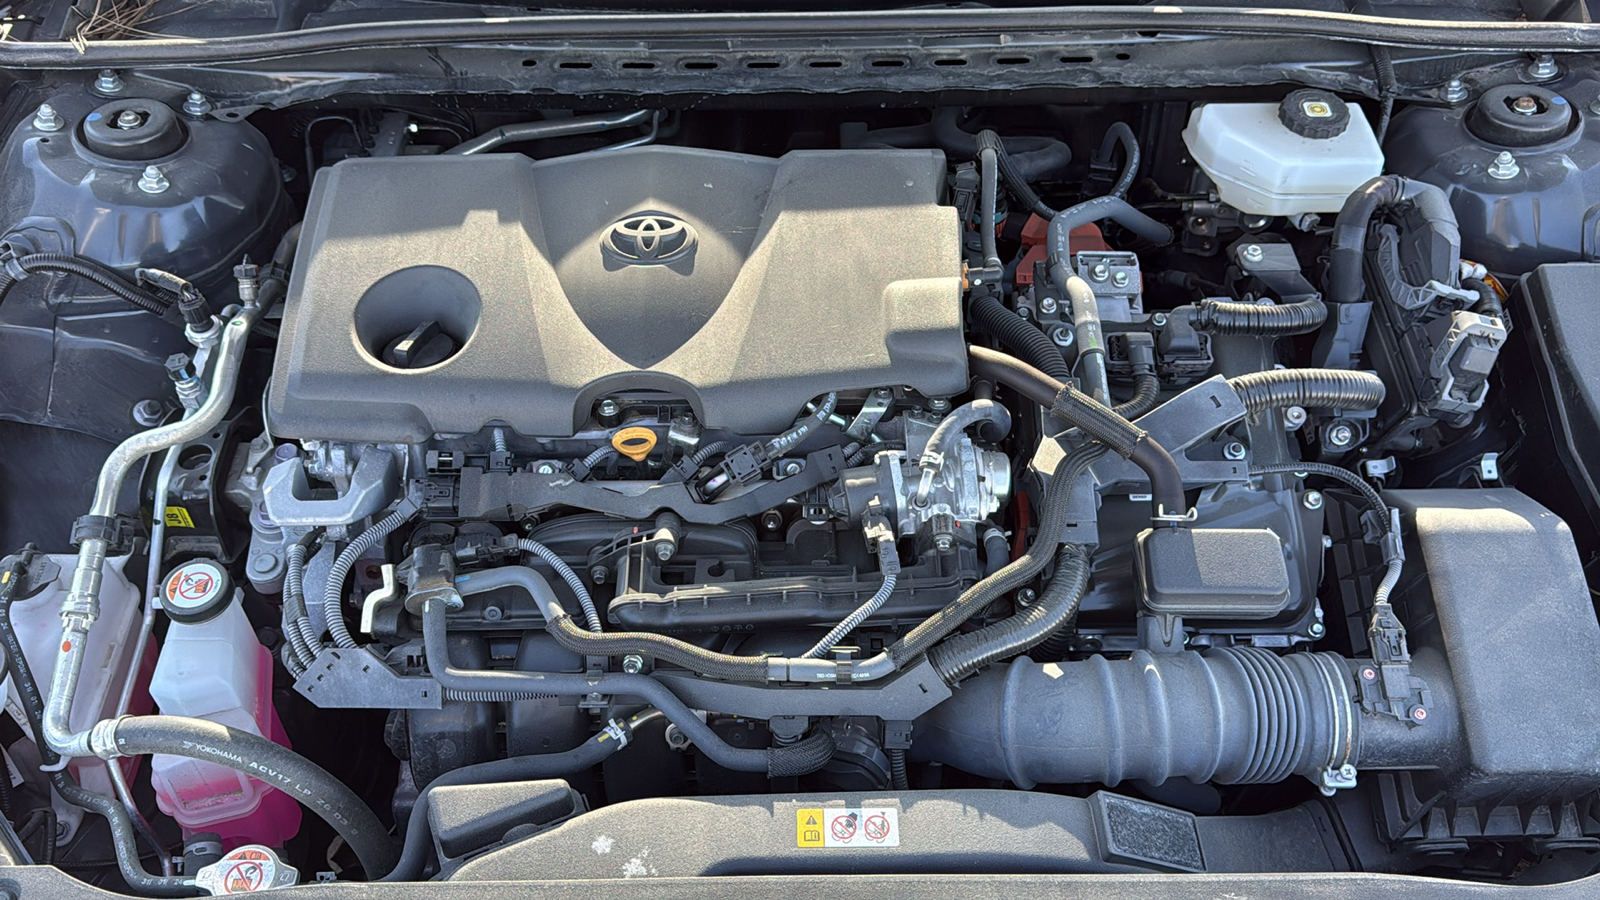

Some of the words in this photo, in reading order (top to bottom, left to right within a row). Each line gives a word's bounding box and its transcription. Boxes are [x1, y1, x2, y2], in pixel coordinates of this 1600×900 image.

[166, 513, 182, 524] J8
[196, 743, 242, 763] YOKOHAMA
[249, 761, 292, 784] ACV17
[295, 783, 312, 796] LP
